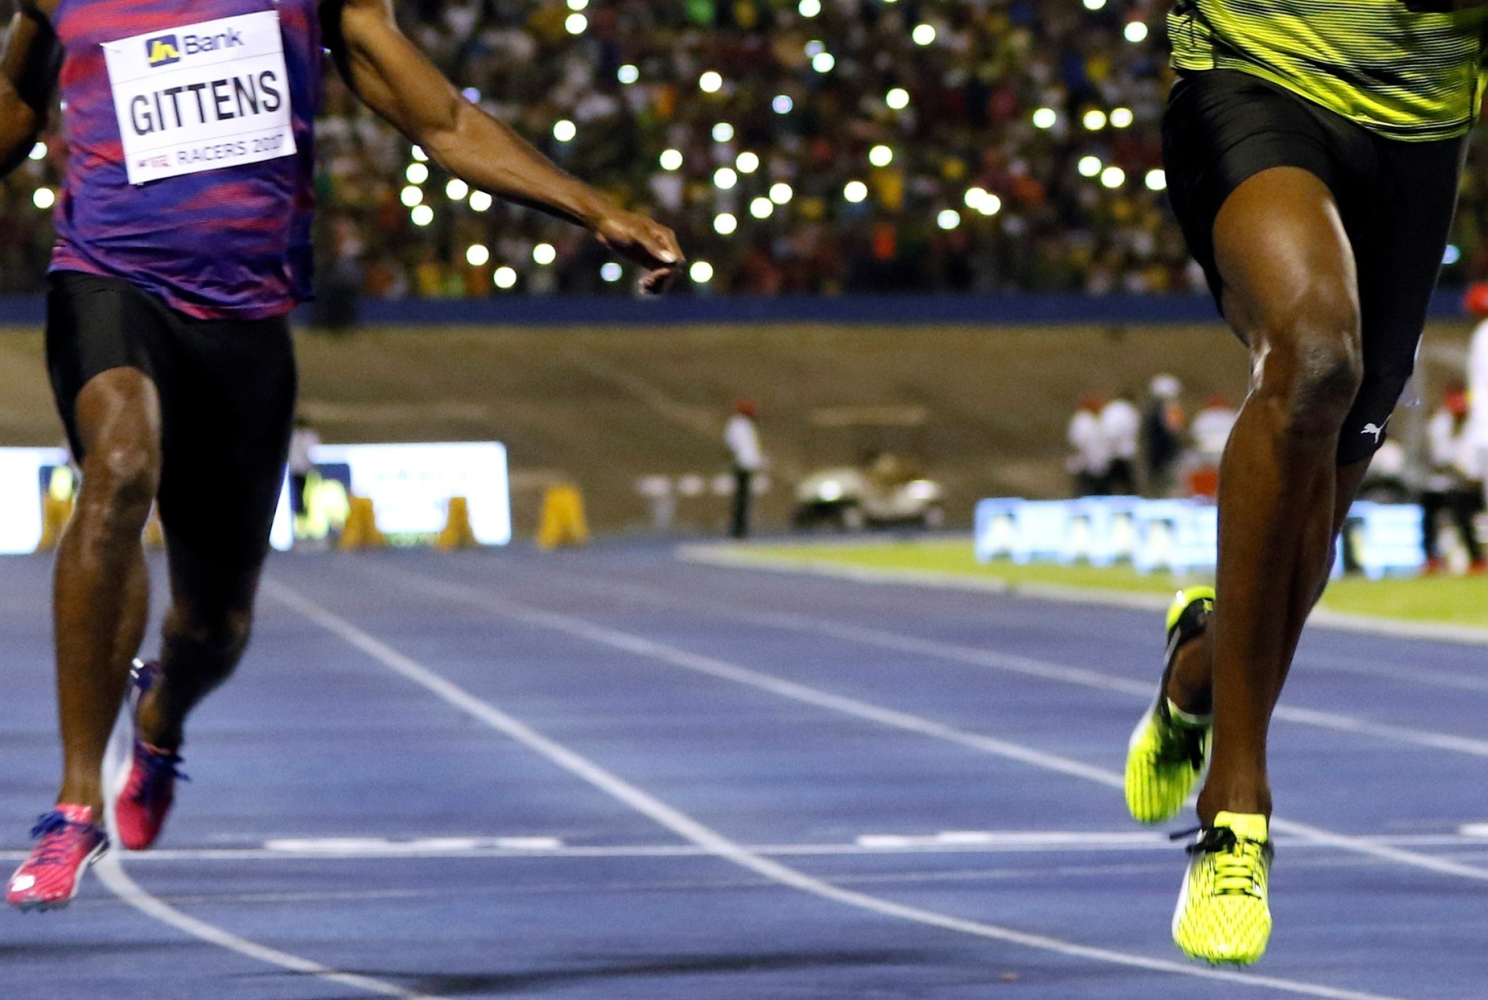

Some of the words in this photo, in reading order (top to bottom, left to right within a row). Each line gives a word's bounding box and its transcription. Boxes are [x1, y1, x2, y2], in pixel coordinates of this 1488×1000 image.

[183, 27, 245, 55] Bank
[131, 70, 280, 136] GITTENS
[177, 140, 247, 165] RACERS
